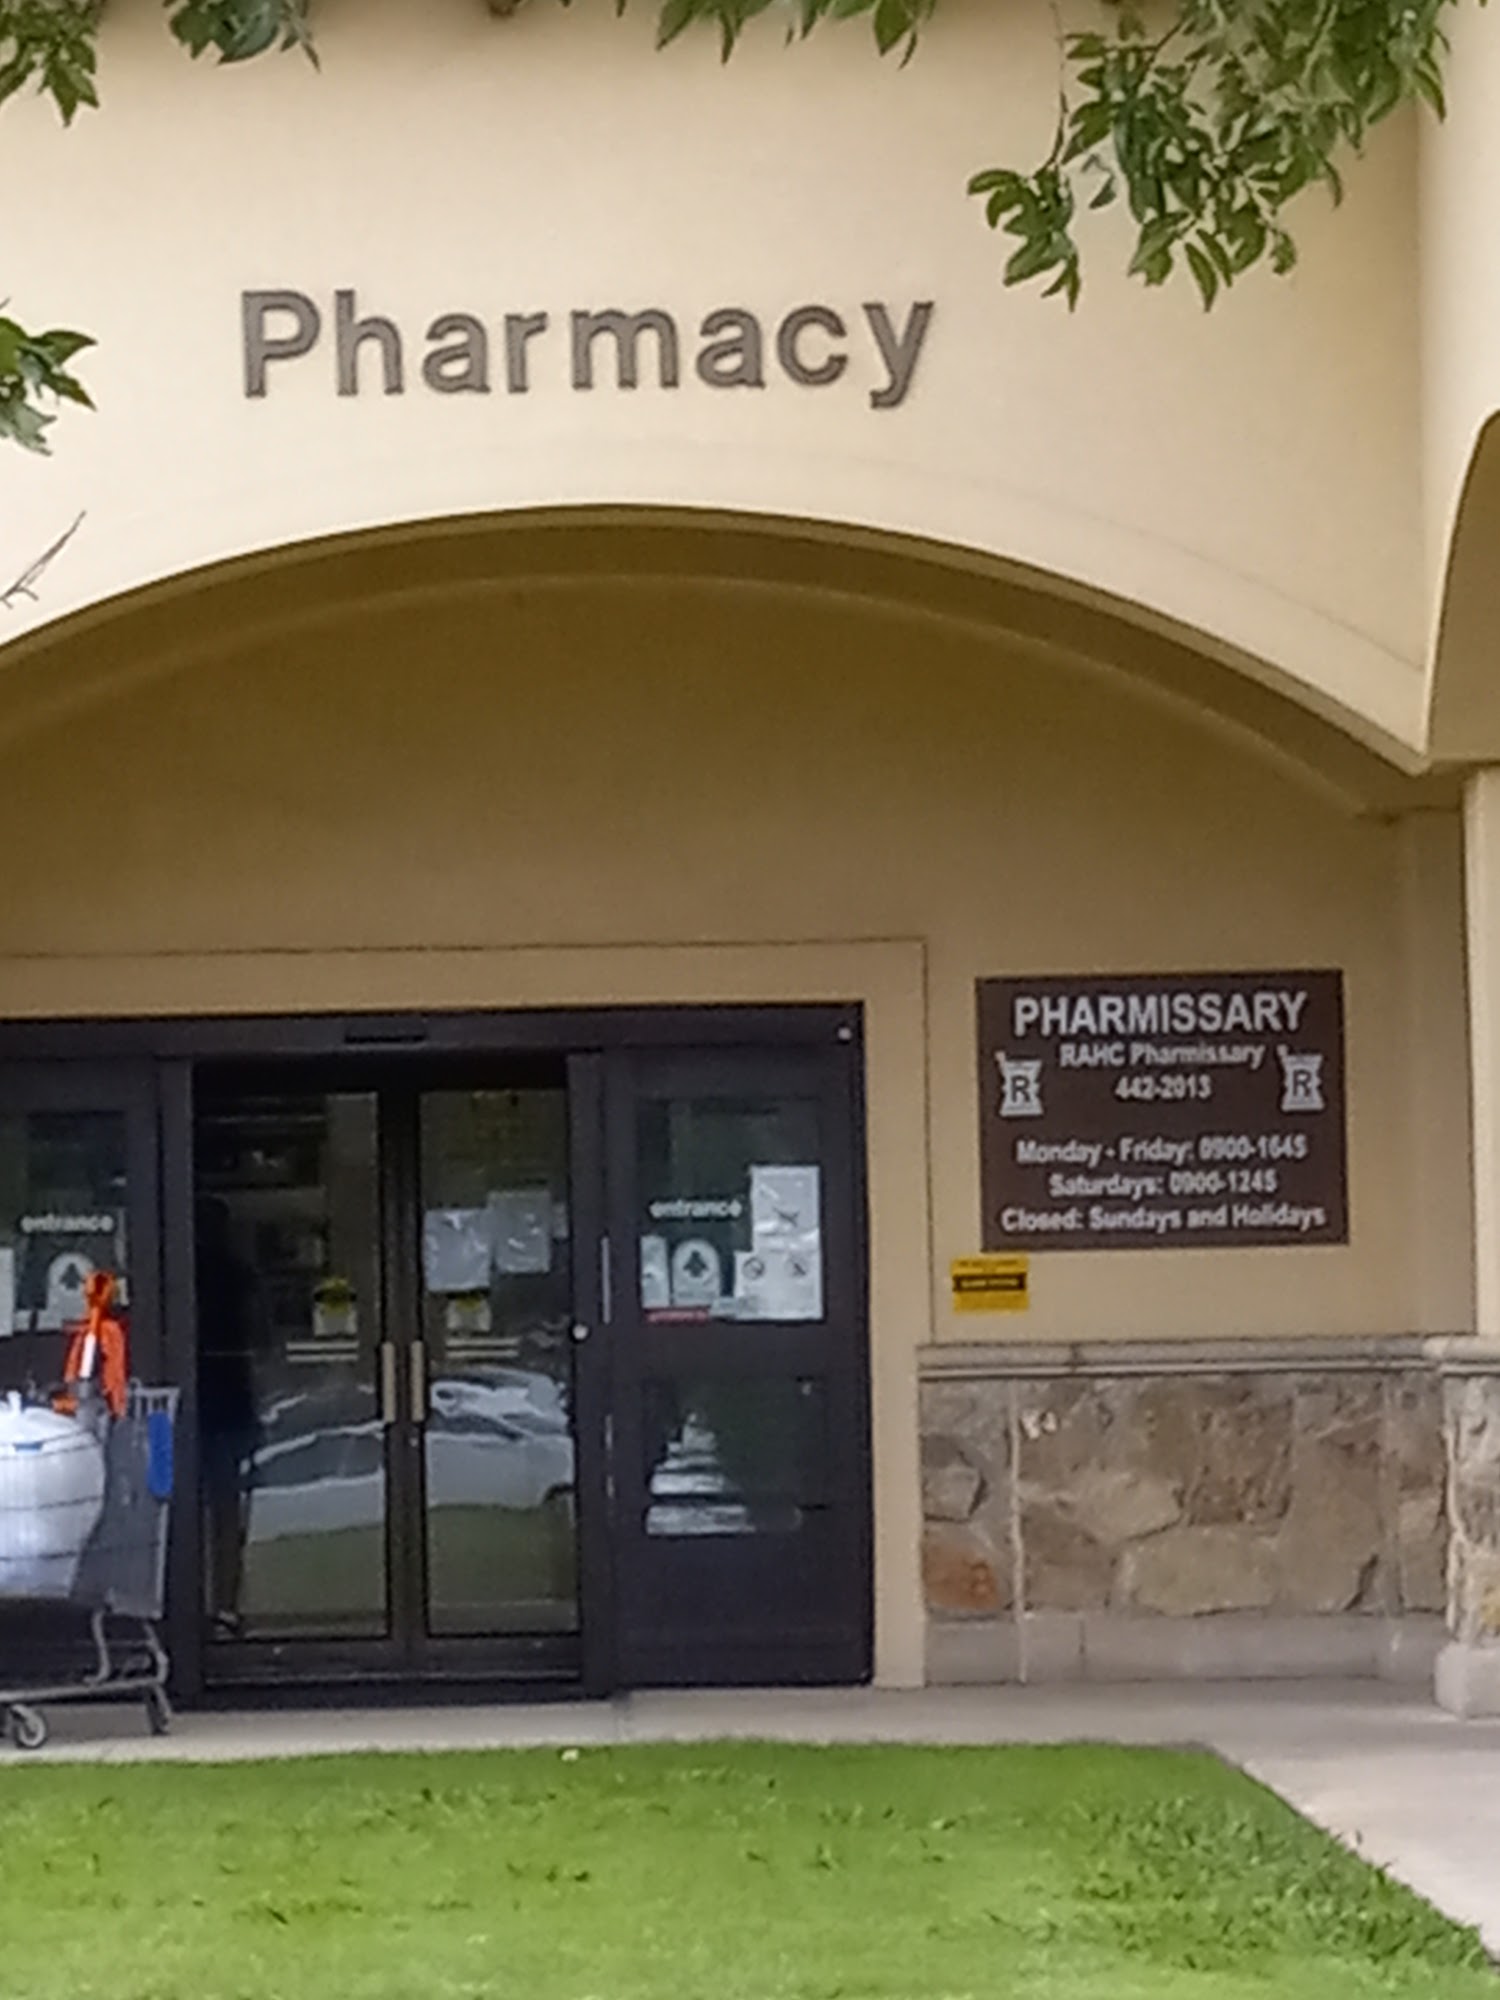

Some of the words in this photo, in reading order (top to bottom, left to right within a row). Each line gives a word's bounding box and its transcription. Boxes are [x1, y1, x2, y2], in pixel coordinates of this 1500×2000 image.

[241, 289, 934, 408] Pharmacy
[1014, 992, 1306, 1036] PHARMISSARY
[1058, 1043, 1125, 1067] RAHC
[1130, 1043, 1265, 1070] Pharmissary
[1016, 1140, 1101, 1167] Monday
[1119, 1137, 1194, 1166] Friday:
[1049, 1173, 1164, 1201] Saturdays:
[1001, 1207, 1083, 1231] Closed:
[1089, 1206, 1182, 1233] Sundays
[1187, 1204, 1228, 1227] and
[1232, 1202, 1327, 1230] Holidays
